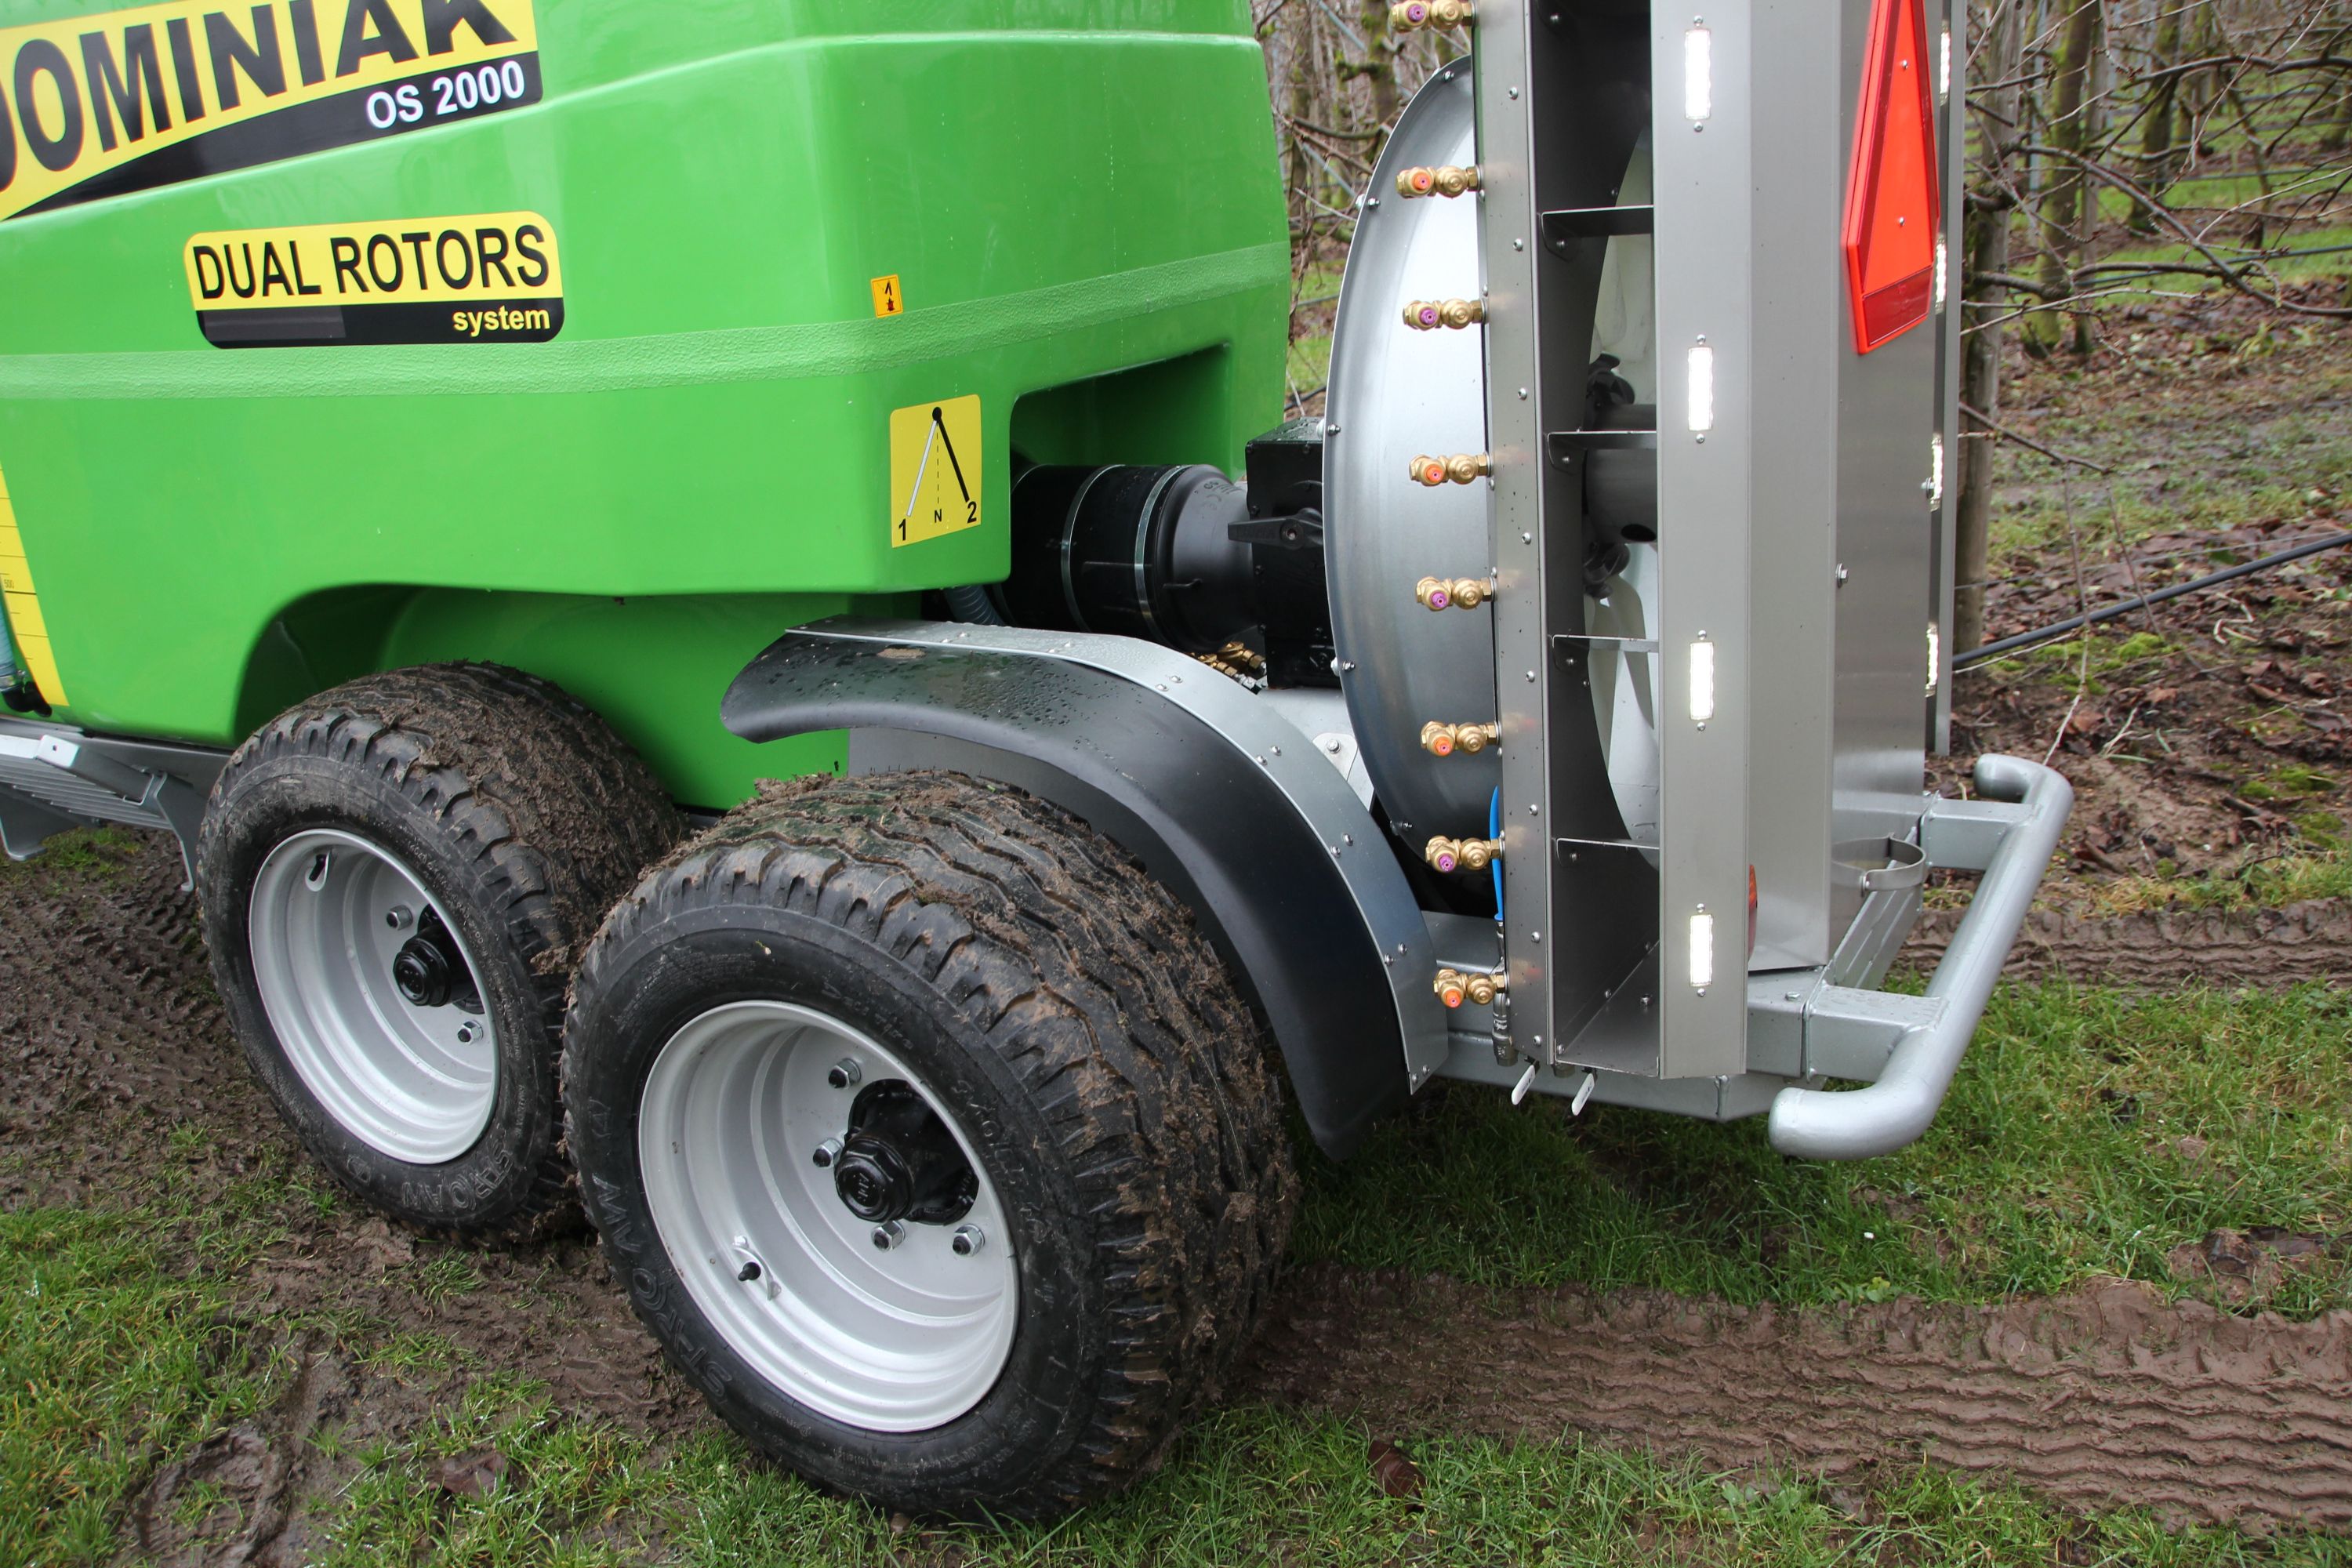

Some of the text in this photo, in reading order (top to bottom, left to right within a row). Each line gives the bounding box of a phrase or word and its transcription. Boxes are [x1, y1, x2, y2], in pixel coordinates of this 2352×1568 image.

[0, 0, 518, 193] OMINIAK
[366, 60, 526, 129] OS 2000
[192, 223, 550, 300] DUAL ROTORS
[452, 305, 551, 337] system
[898, 501, 978, 541] 1 N 2
